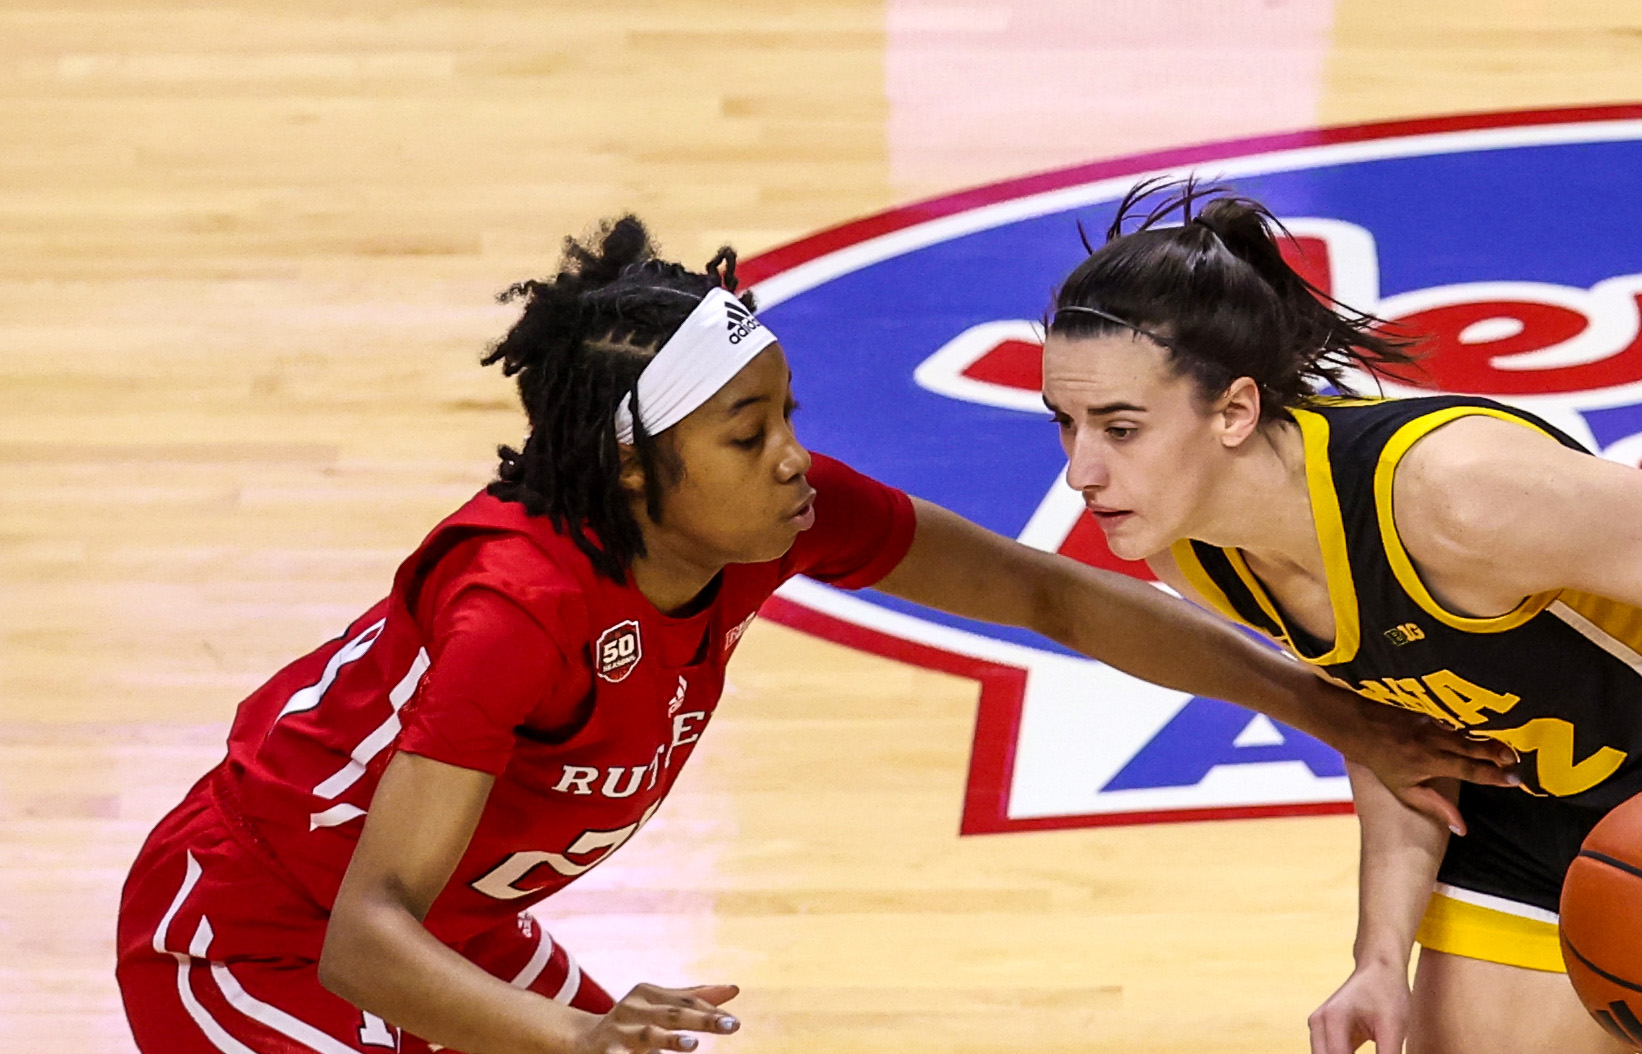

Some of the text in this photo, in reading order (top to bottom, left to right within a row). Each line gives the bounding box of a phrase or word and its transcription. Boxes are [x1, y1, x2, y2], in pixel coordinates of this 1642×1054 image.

[603, 633, 636, 664] 50
[1466, 717, 1628, 797] 2
[471, 797, 662, 900] 2
